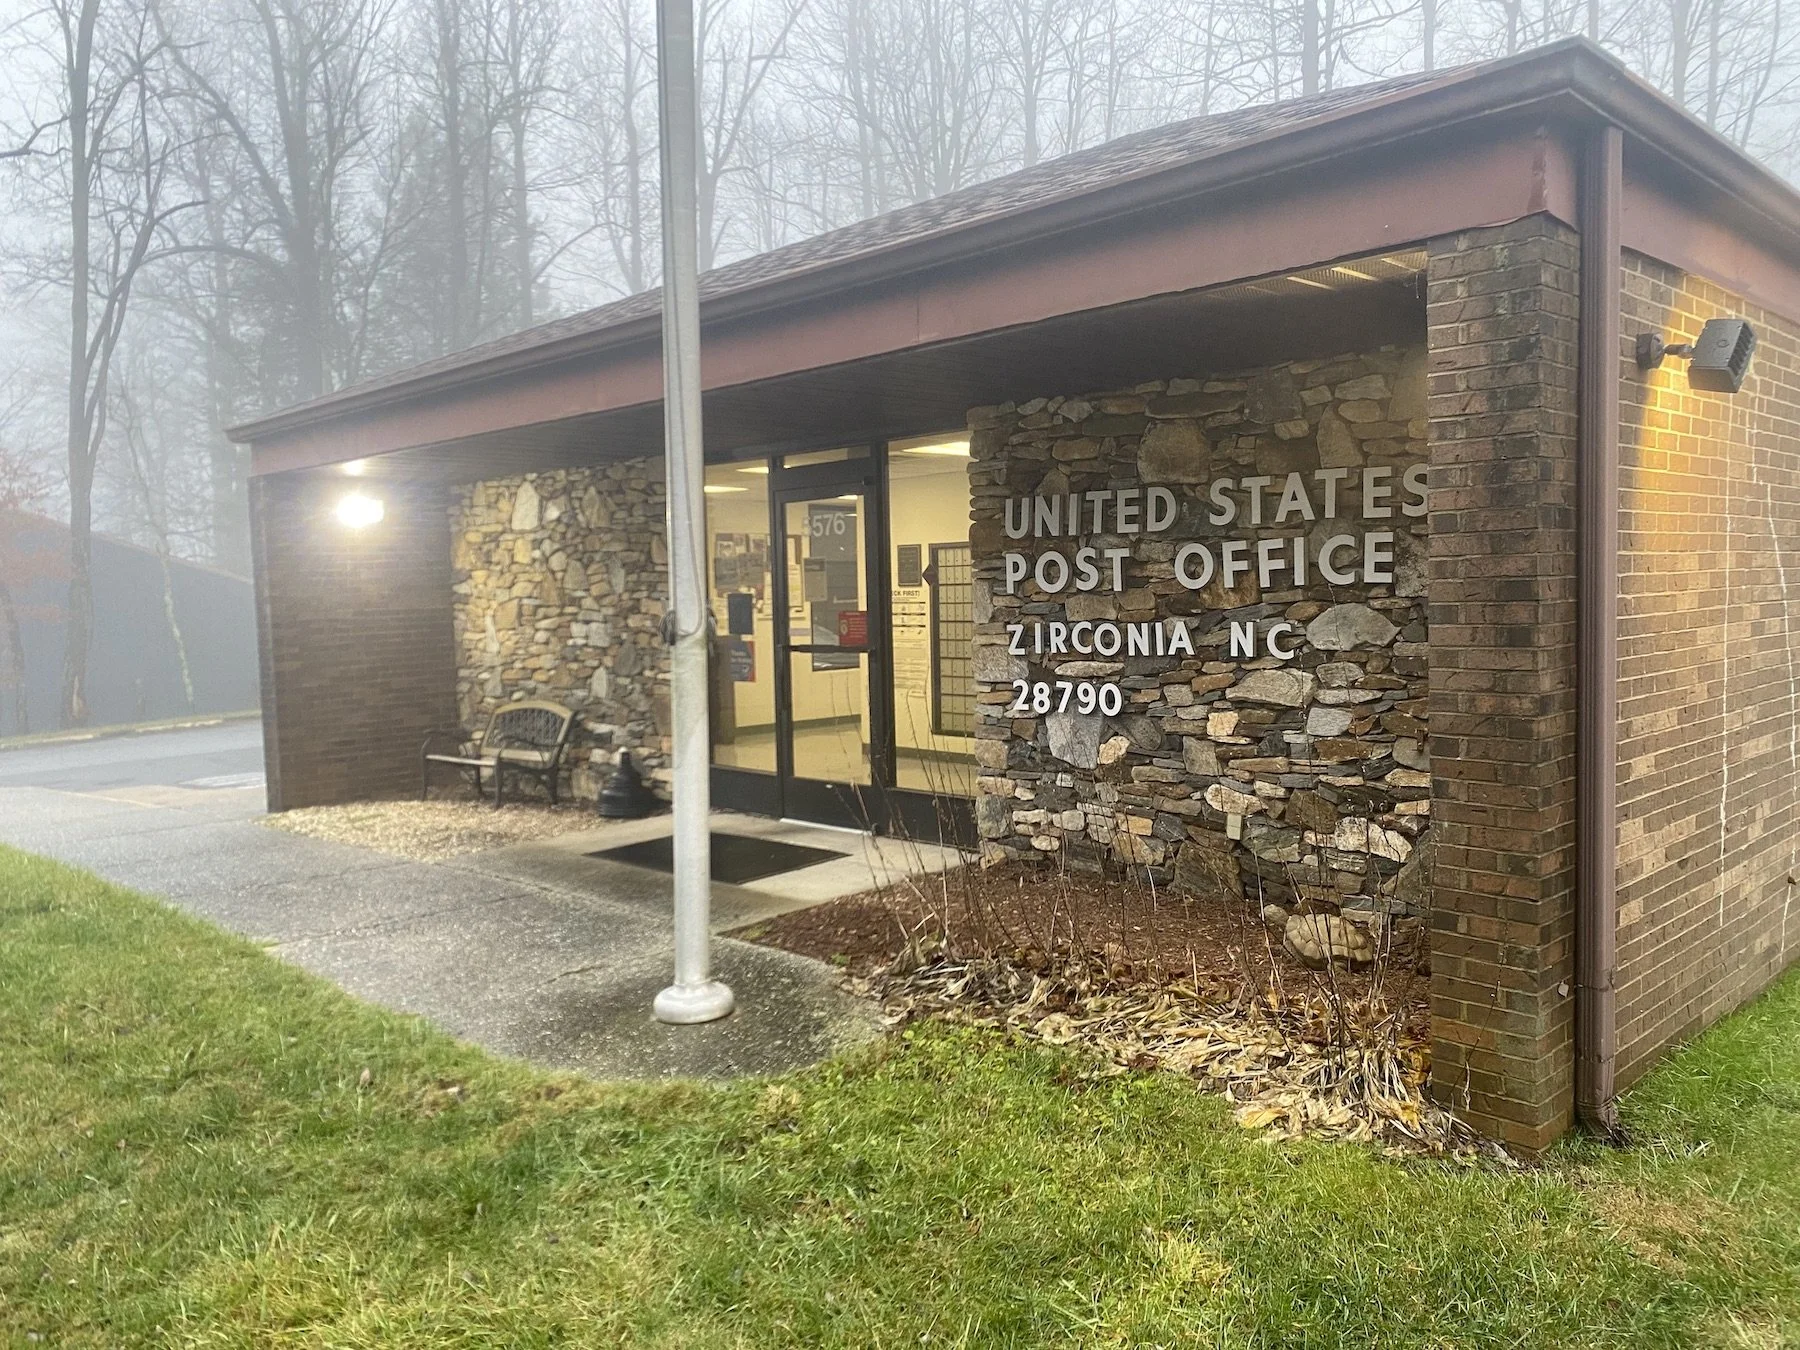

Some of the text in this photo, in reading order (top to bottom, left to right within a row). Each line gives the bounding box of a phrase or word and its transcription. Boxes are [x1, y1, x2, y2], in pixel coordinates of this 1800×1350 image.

[1004, 463, 1429, 540] UNITED STATES
[1005, 532, 1394, 594] POST OFFICE
[1006, 621, 1296, 660] ZIRCONIA NC
[1012, 680, 1123, 717] 28790
